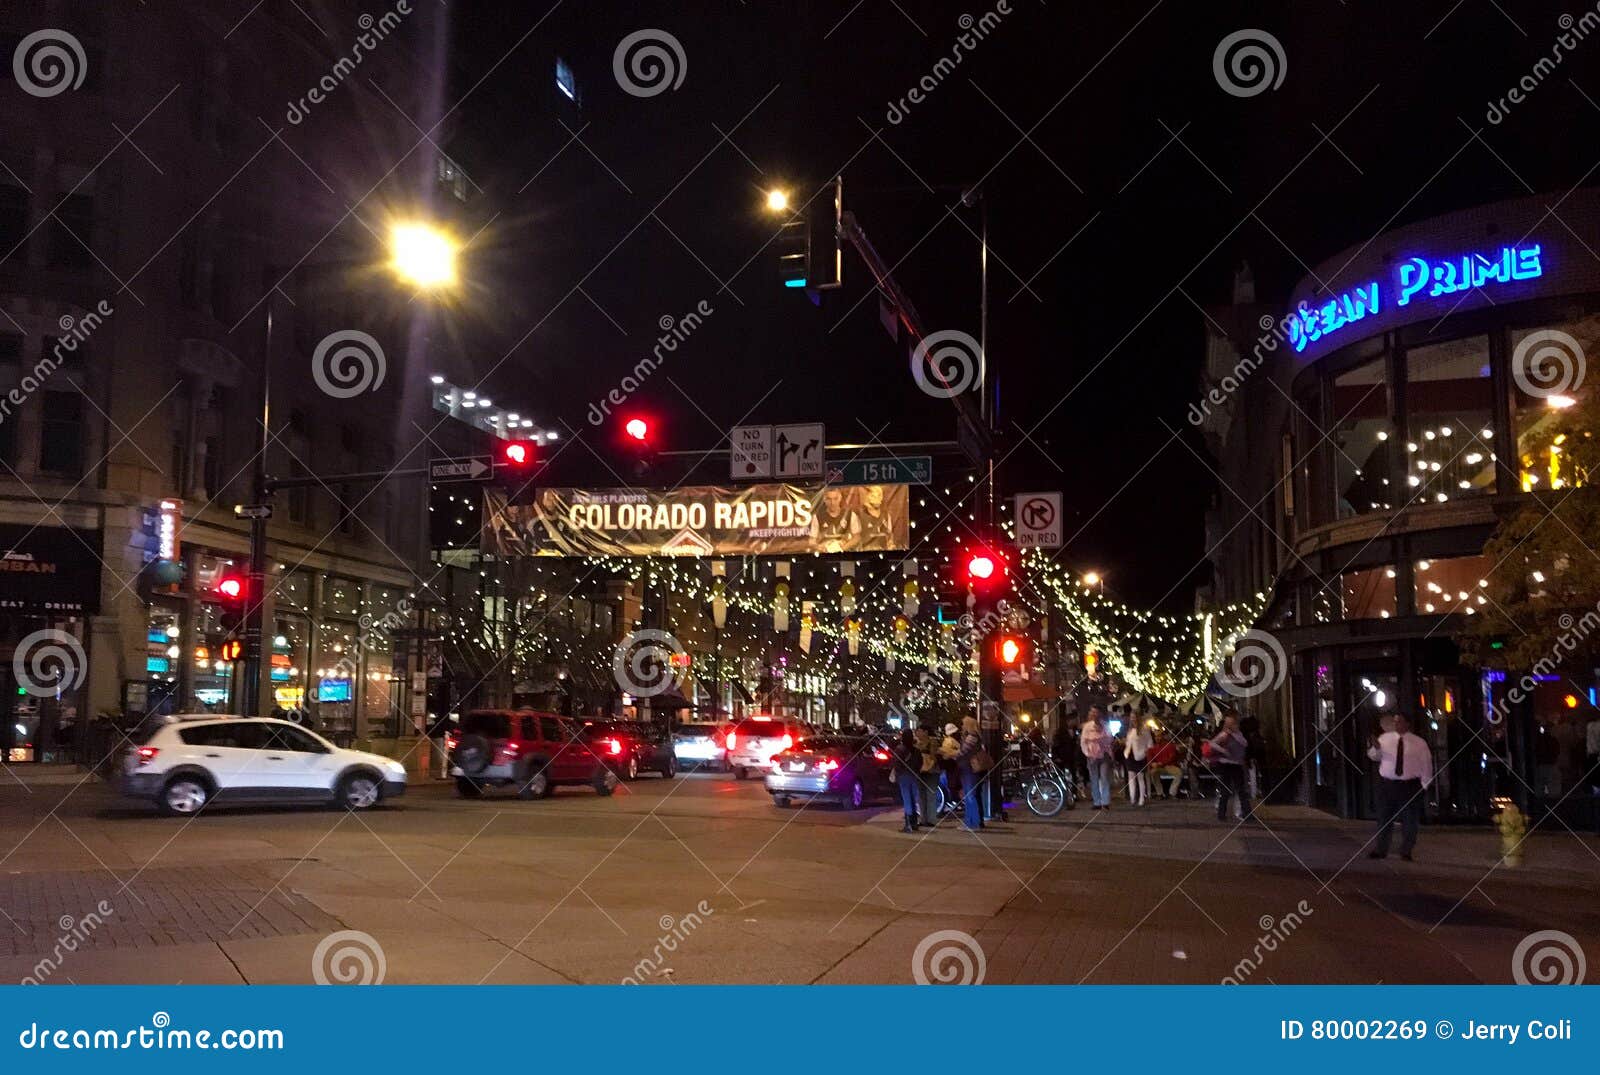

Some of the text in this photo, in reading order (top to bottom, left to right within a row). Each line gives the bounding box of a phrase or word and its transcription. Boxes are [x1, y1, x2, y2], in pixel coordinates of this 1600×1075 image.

[1397, 243, 1543, 306] PRIME
[743, 430, 761, 440] NO
[740, 442, 764, 451] TURN
[734, 452, 769, 463] ON RED
[434, 463, 471, 475] ONE WAY
[801, 462, 819, 473] ONLY
[863, 463, 897, 481] 15th
[569, 500, 812, 530] COLORADO RAPIDS
[1021, 533, 1057, 545] ON RED
[45, 602, 82, 610] DRINK
